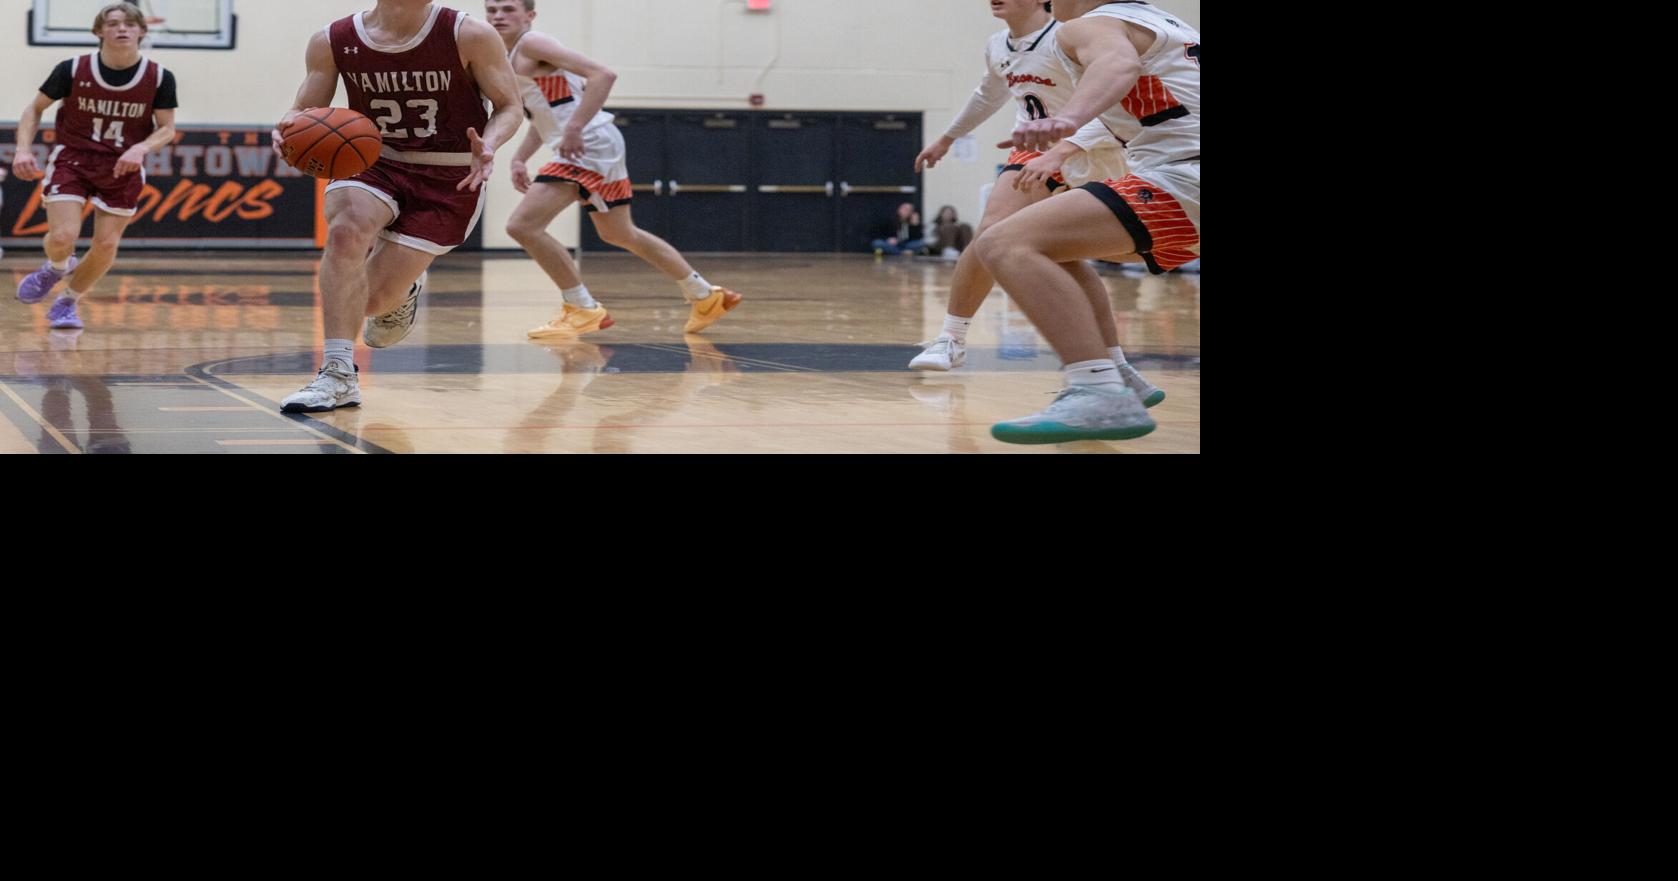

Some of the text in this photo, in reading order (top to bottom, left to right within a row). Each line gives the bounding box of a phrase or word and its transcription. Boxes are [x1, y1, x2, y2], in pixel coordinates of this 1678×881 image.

[78, 96, 147, 118] HAMILTON
[370, 98, 438, 139] 23
[91, 117, 125, 148] 14
